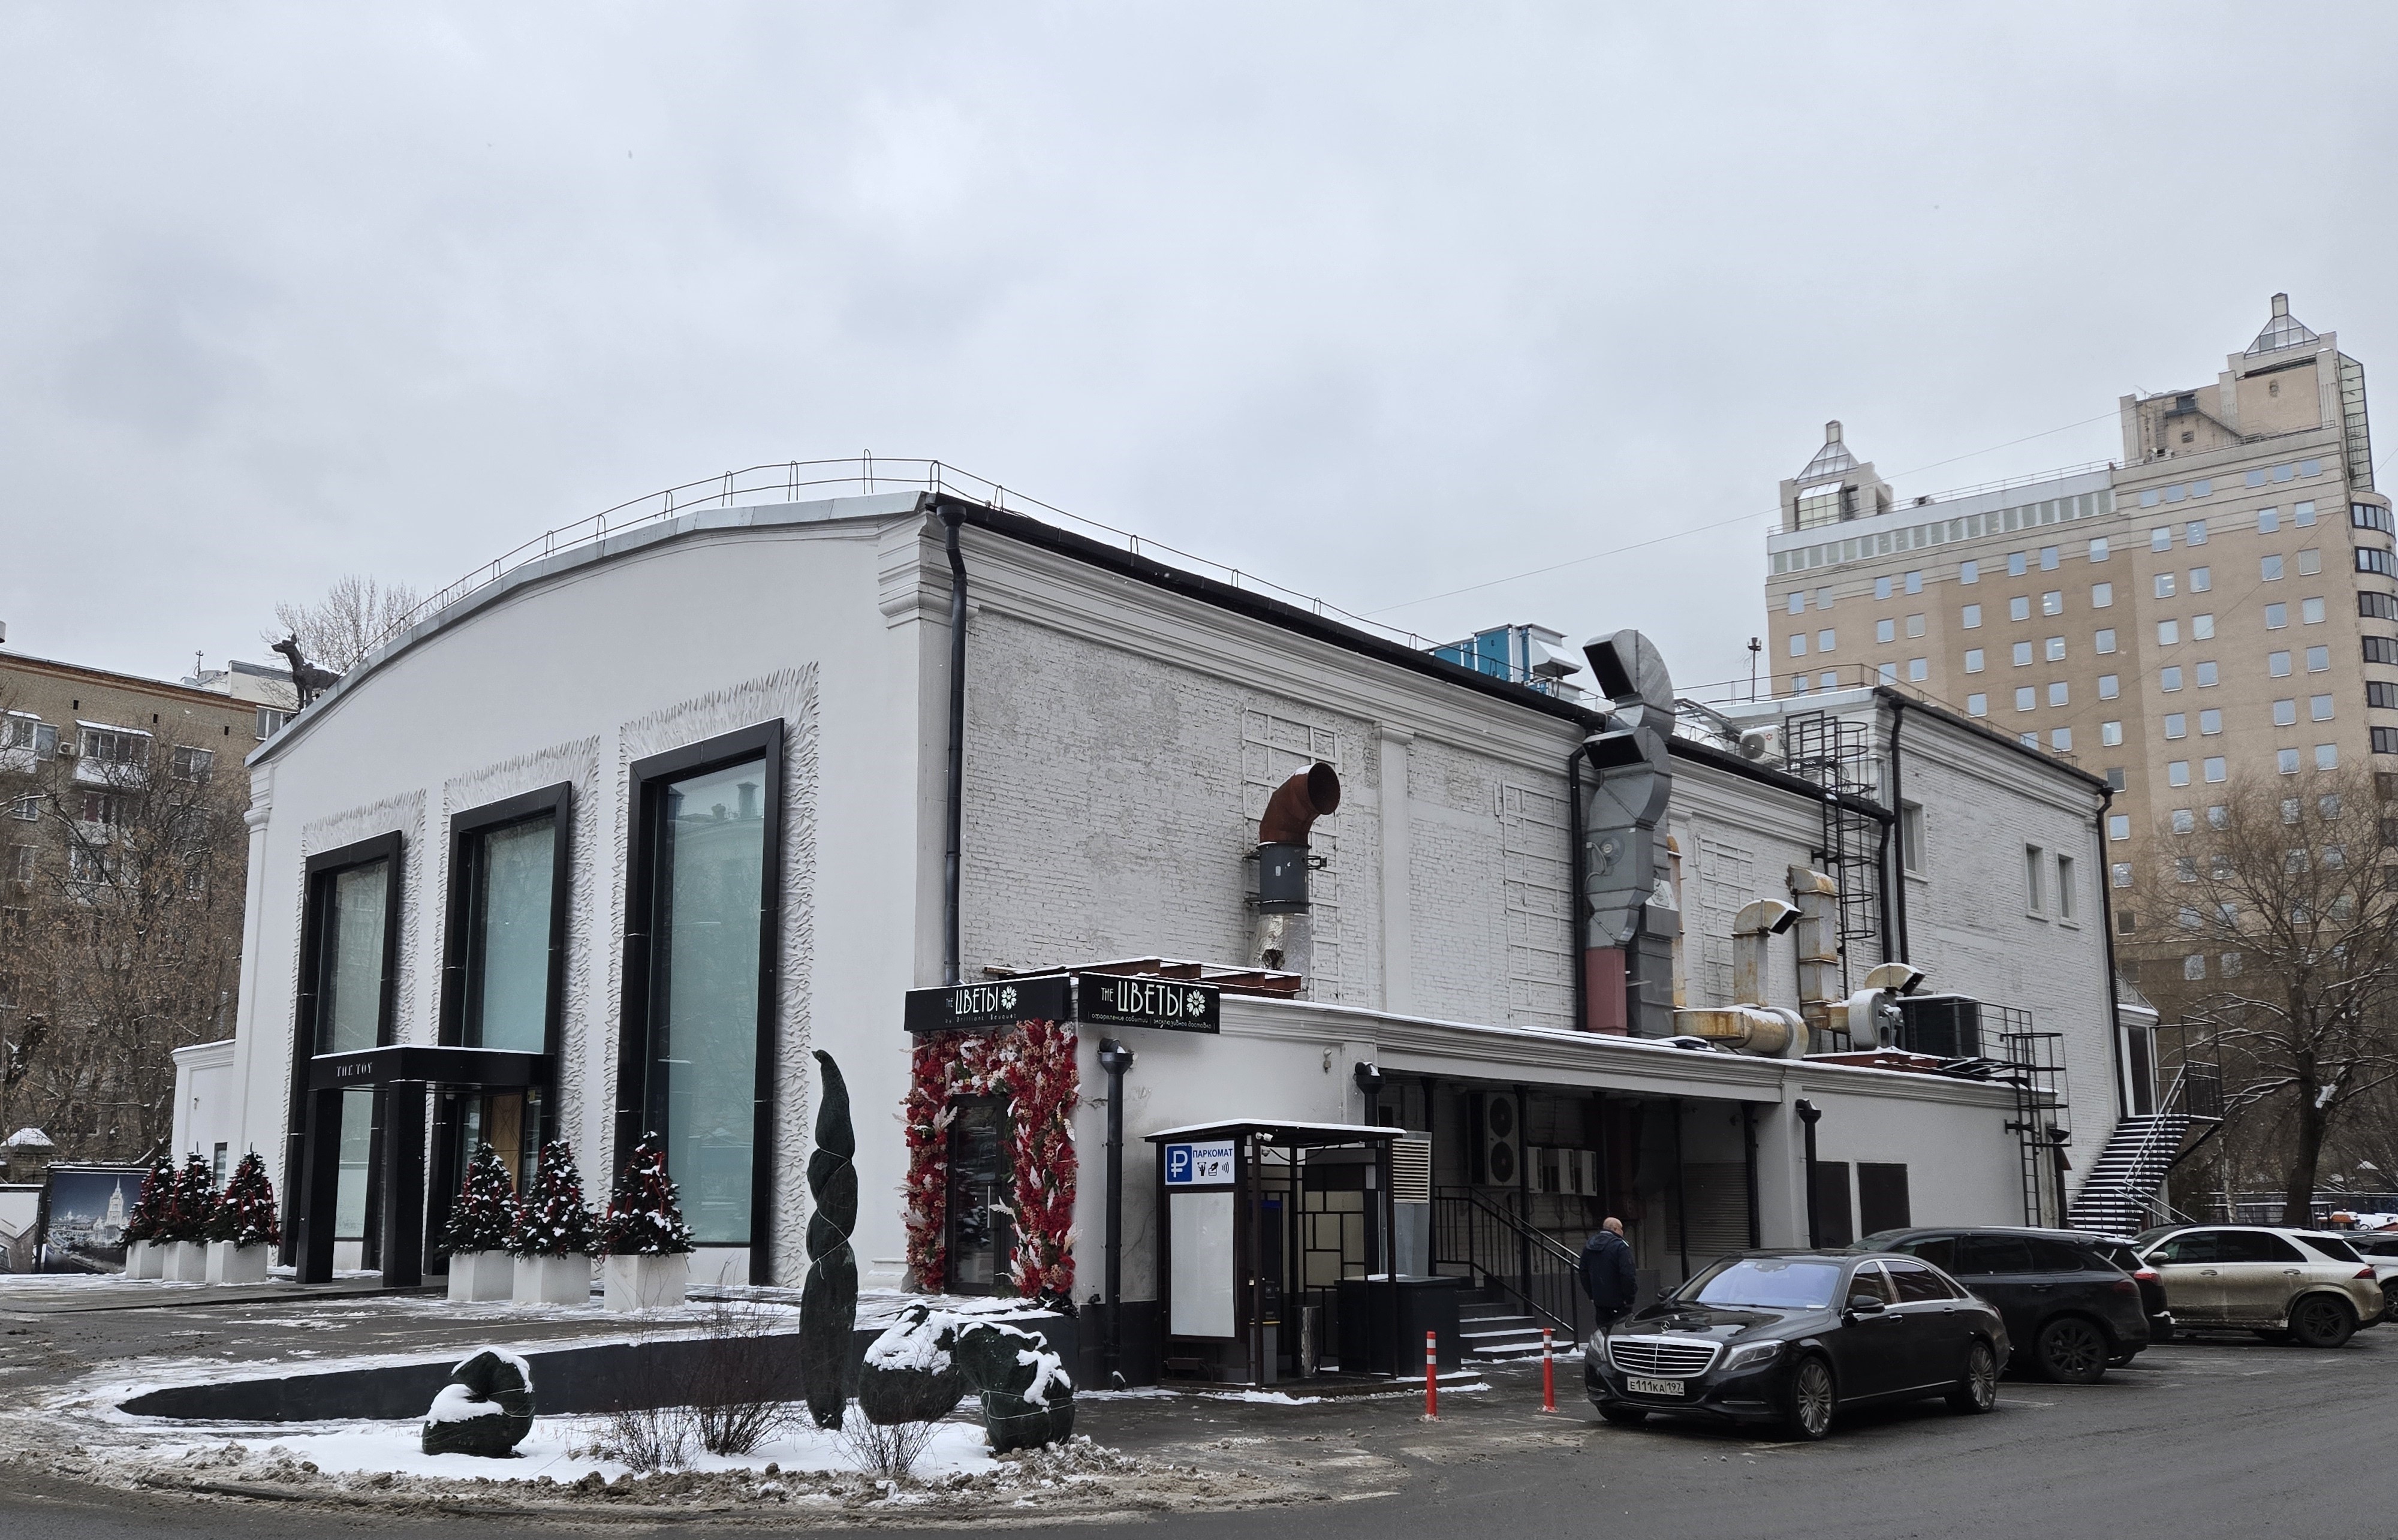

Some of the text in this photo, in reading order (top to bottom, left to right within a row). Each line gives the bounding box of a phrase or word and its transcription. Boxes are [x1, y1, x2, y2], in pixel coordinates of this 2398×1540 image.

[955, 986, 999, 1014] ЦВЕТЫ
[1101, 980, 1183, 1018] THE ЦВЕТЫ
[336, 1062, 372, 1077] THE TOY
[1192, 1148, 1233, 1158] ПАРКОМАТ
[1667, 1382, 1681, 1391] 197
